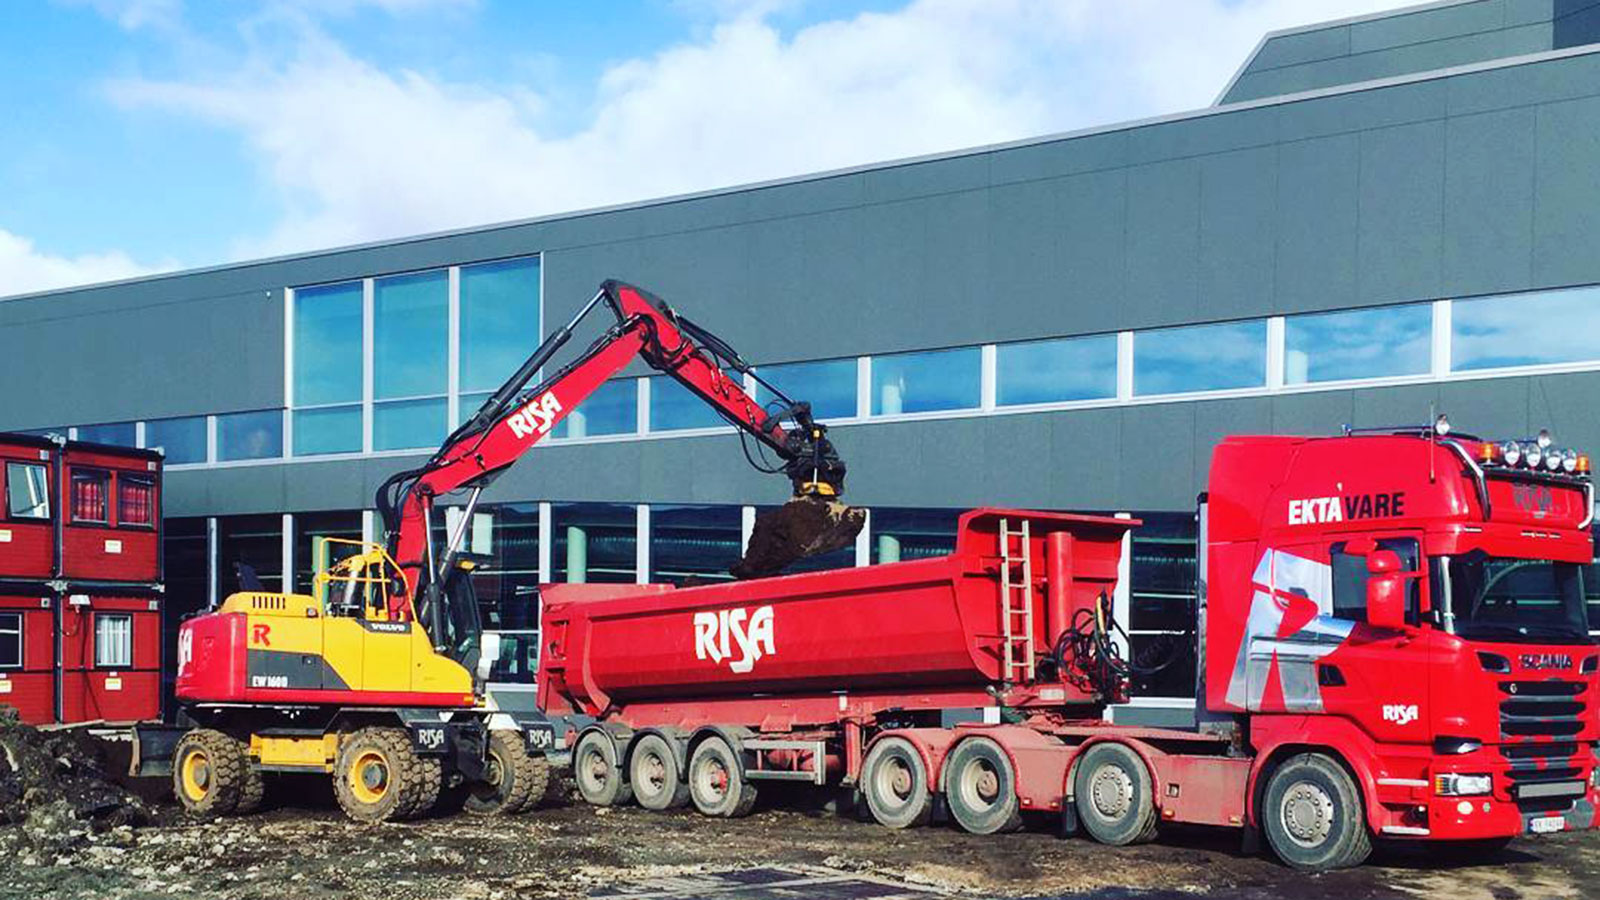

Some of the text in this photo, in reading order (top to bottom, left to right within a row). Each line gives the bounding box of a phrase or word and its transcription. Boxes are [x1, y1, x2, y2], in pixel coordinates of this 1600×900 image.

[507, 391, 562, 439] RISA
[1288, 492, 1405, 525] EKTA VARE
[371, 623, 406, 632] VOLVO
[693, 605, 776, 674] RISA
[1519, 654, 1573, 669] SCANIA
[1382, 704, 1419, 725] RISA
[418, 729, 444, 749] RISA
[529, 729, 552, 748] RISA
